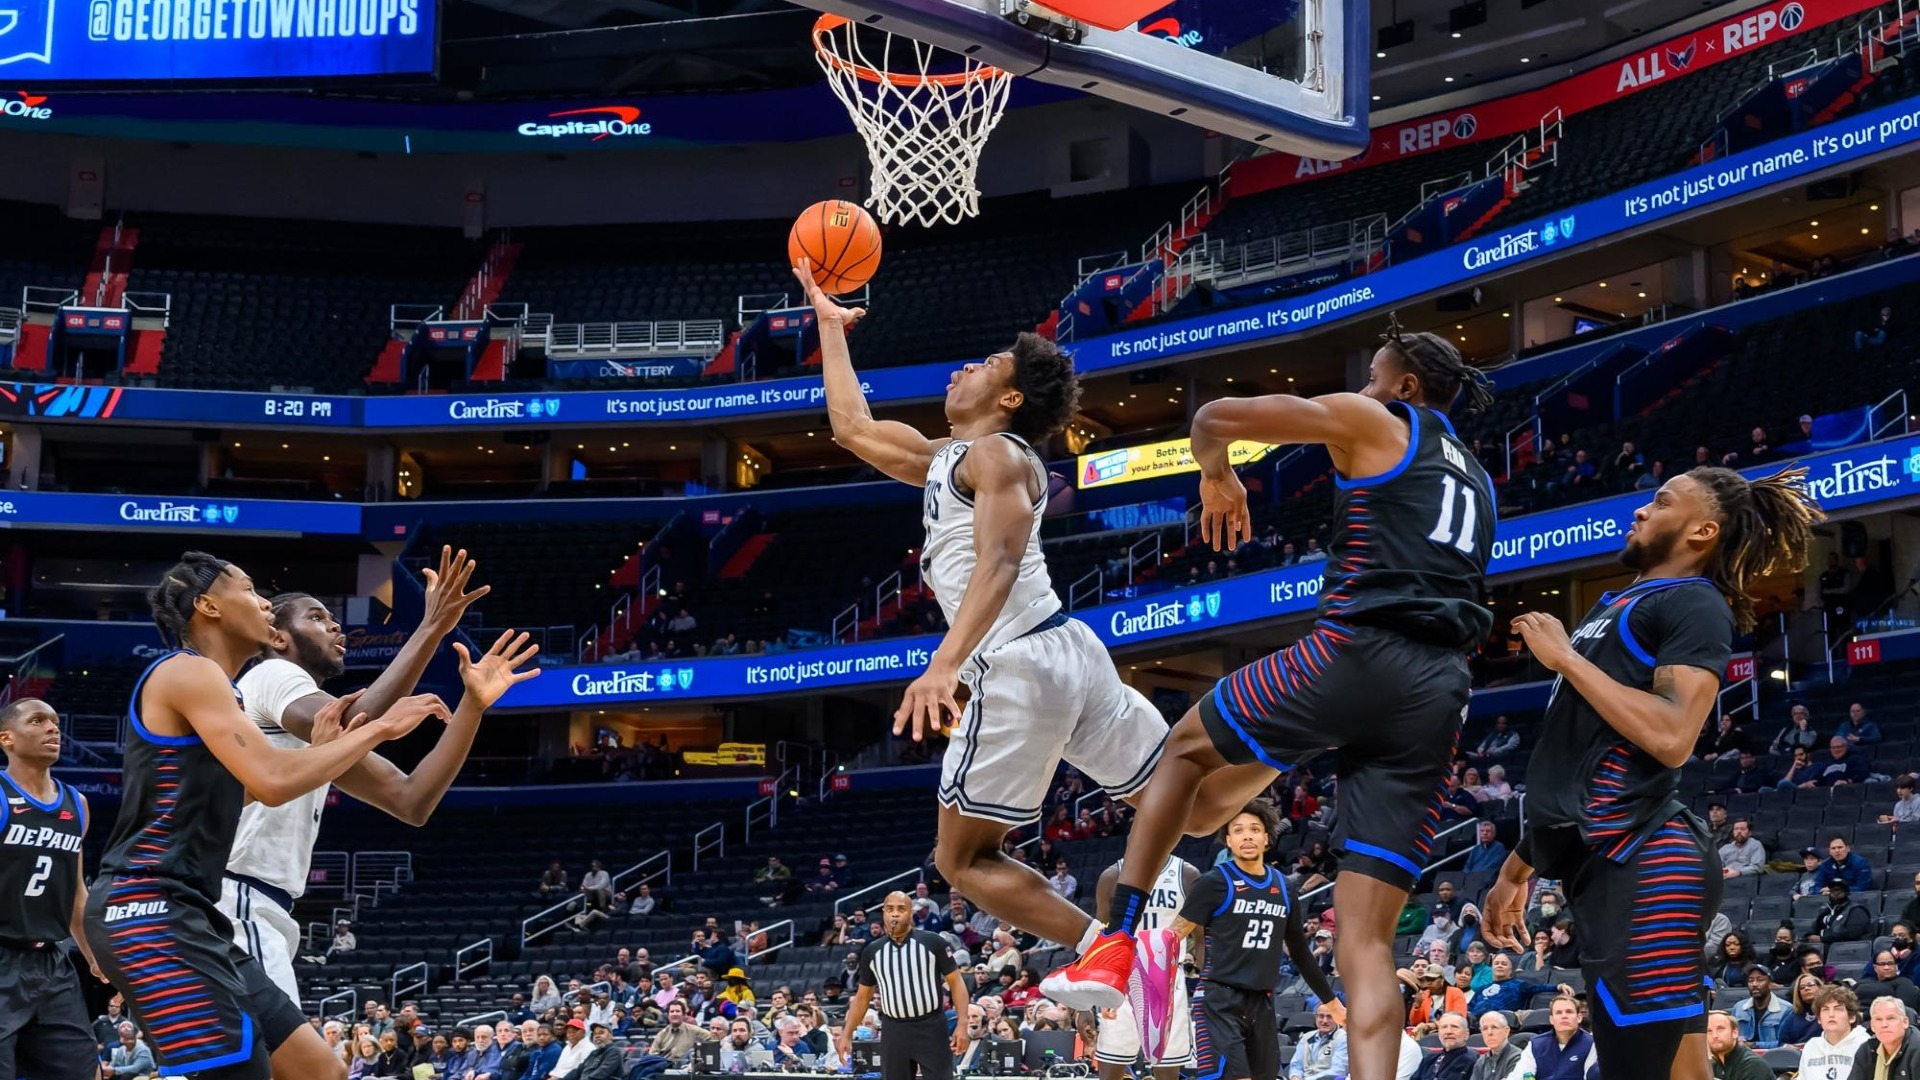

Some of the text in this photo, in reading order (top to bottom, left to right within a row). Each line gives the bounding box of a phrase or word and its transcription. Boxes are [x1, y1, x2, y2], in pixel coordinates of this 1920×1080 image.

[88, 0, 418, 41] @GEORGETOWNHOOPS
[1616, 52, 1665, 92] ALL
[1723, 10, 1777, 53] REP
[1400, 119, 1451, 154] REP
[1626, 196, 1647, 216] It's
[1652, 185, 1679, 208] not
[1682, 174, 1715, 204] just
[1718, 164, 1748, 187] our
[1752, 149, 1808, 178] name.
[1813, 136, 1838, 158] It's
[1842, 125, 1875, 149] our
[1112, 286, 1375, 357] It's not just our name. It's our promise.
[265, 400, 332, 417] 8:20 PM
[607, 399, 627, 413] It's
[630, 399, 655, 412] not
[656, 397, 685, 416] just
[687, 397, 712, 410] our
[715, 393, 759, 408] name.
[761, 388, 781, 403] It's
[783, 388, 808, 401] our
[1132, 465, 1150, 475] your
[1153, 461, 1174, 470] bank
[1232, 449, 1251, 457] ask.
[1156, 447, 1177, 458] Both
[1429, 474, 1476, 553] 11
[1492, 518, 1622, 559] our promise.
[1271, 574, 1325, 602] It's not
[747, 667, 767, 684] It's
[770, 664, 795, 682] not
[796, 661, 824, 684] just
[827, 659, 853, 675] our
[855, 654, 903, 672] name.
[907, 649, 928, 666] It's
[1732, 662, 1752, 677] 112
[1854, 645, 1873, 660] 111
[24, 855, 52, 897] 2
[1242, 919, 1274, 950] 23
